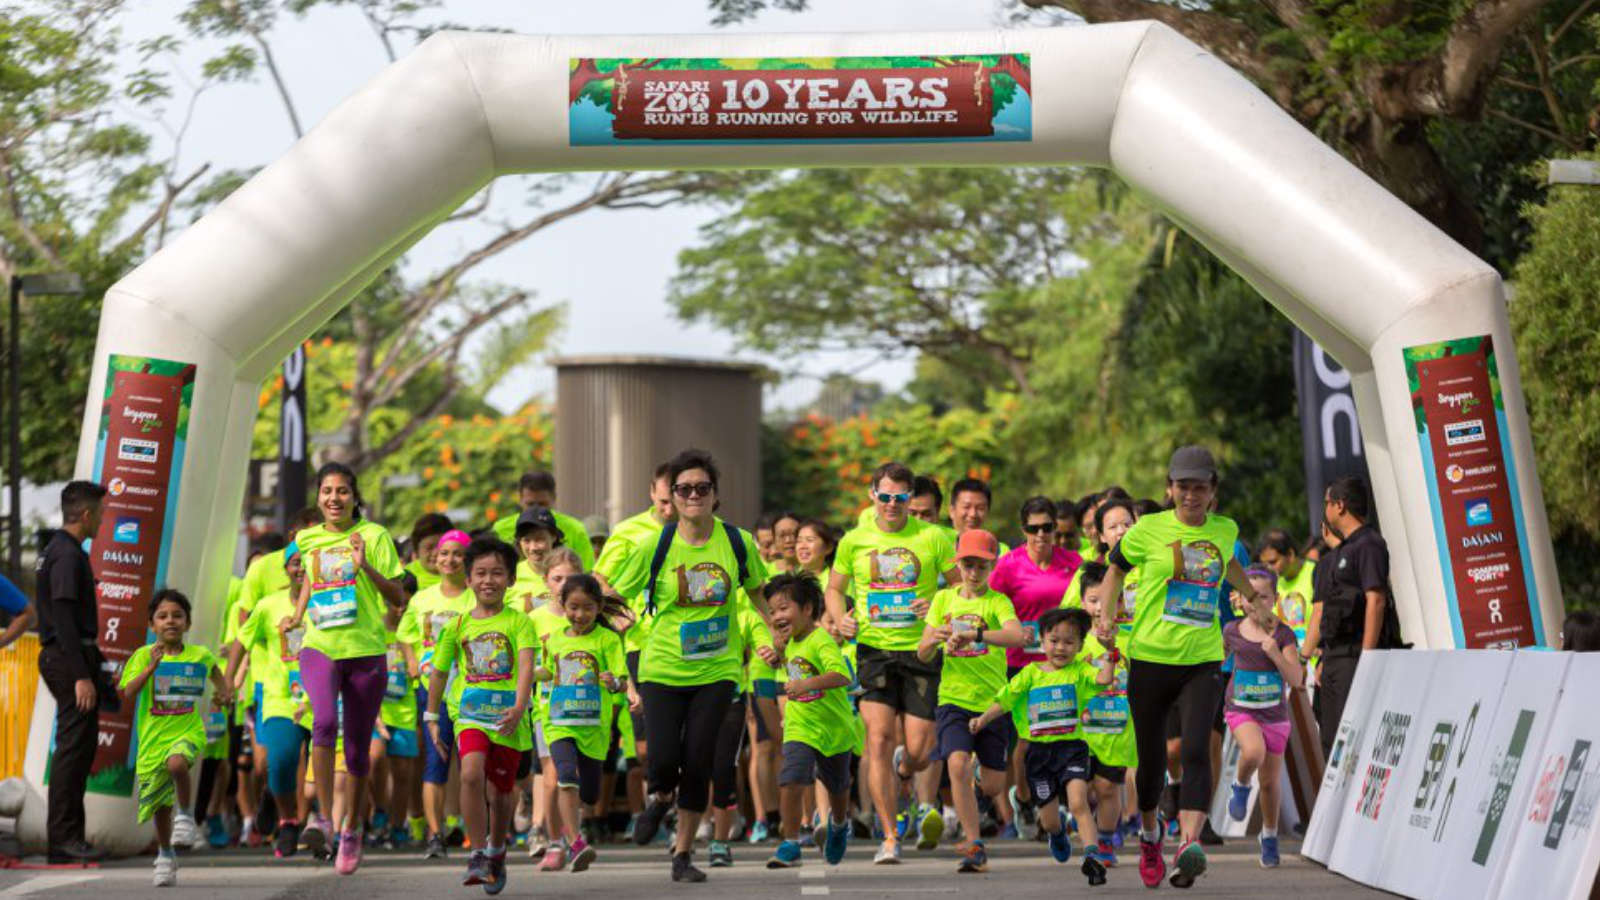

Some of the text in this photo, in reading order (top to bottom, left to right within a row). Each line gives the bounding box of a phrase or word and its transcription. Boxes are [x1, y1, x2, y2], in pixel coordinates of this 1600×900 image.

[643, 81, 710, 93] SAFARI
[721, 77, 949, 110] 10 YEARS
[643, 92, 710, 112] ZOO
[643, 113, 709, 126] RUN'18
[715, 110, 959, 126] RUNNING FOR WILDLIFE
[1461, 531, 1503, 549] DASANI
[103, 549, 143, 566] DASANI
